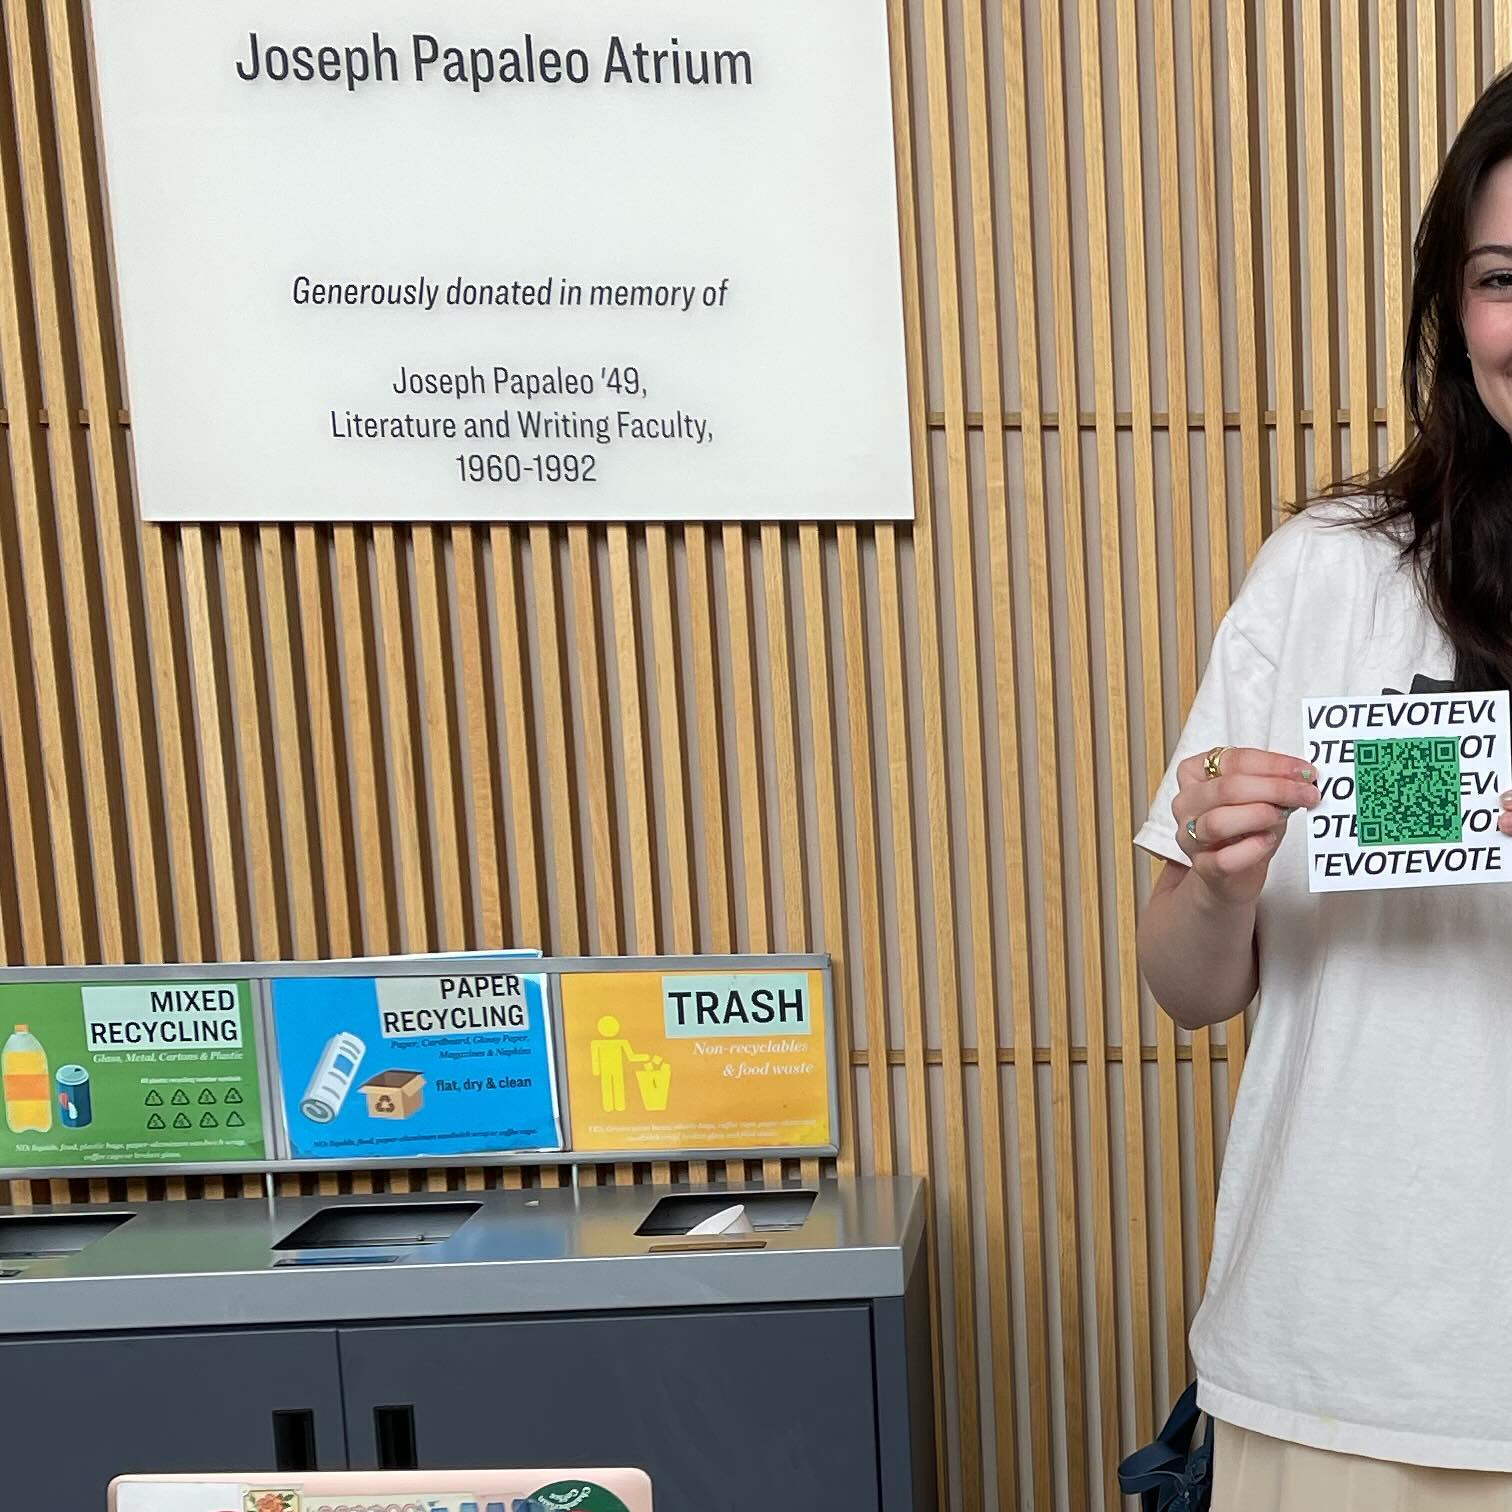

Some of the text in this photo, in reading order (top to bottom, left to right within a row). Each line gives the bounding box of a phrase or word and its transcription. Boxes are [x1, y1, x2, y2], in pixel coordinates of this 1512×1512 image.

[236, 33, 753, 93] Joseph Papaleo Atrium
[292, 276, 729, 311] Generously donated in memory of
[393, 366, 648, 399] Joseph Papaleo '49,
[331, 410, 713, 445] Literature and Writing Faculty,
[456, 454, 597, 484] 1960-1992
[150, 990, 235, 1012] MIXED
[440, 976, 521, 1000] PAPER
[384, 1004, 524, 1033] RECYCLING
[668, 988, 804, 1025] TRASH
[91, 1019, 238, 1045] RECYCLING
[158, 1052, 198, 1062] Cartons
[199, 1051, 208, 1061] &
[210, 1051, 244, 1061] Plastic
[692, 1040, 809, 1055] Non-recyclables
[722, 1063, 814, 1078] & food waste
[436, 1077, 532, 1092] flat, dry & clean
